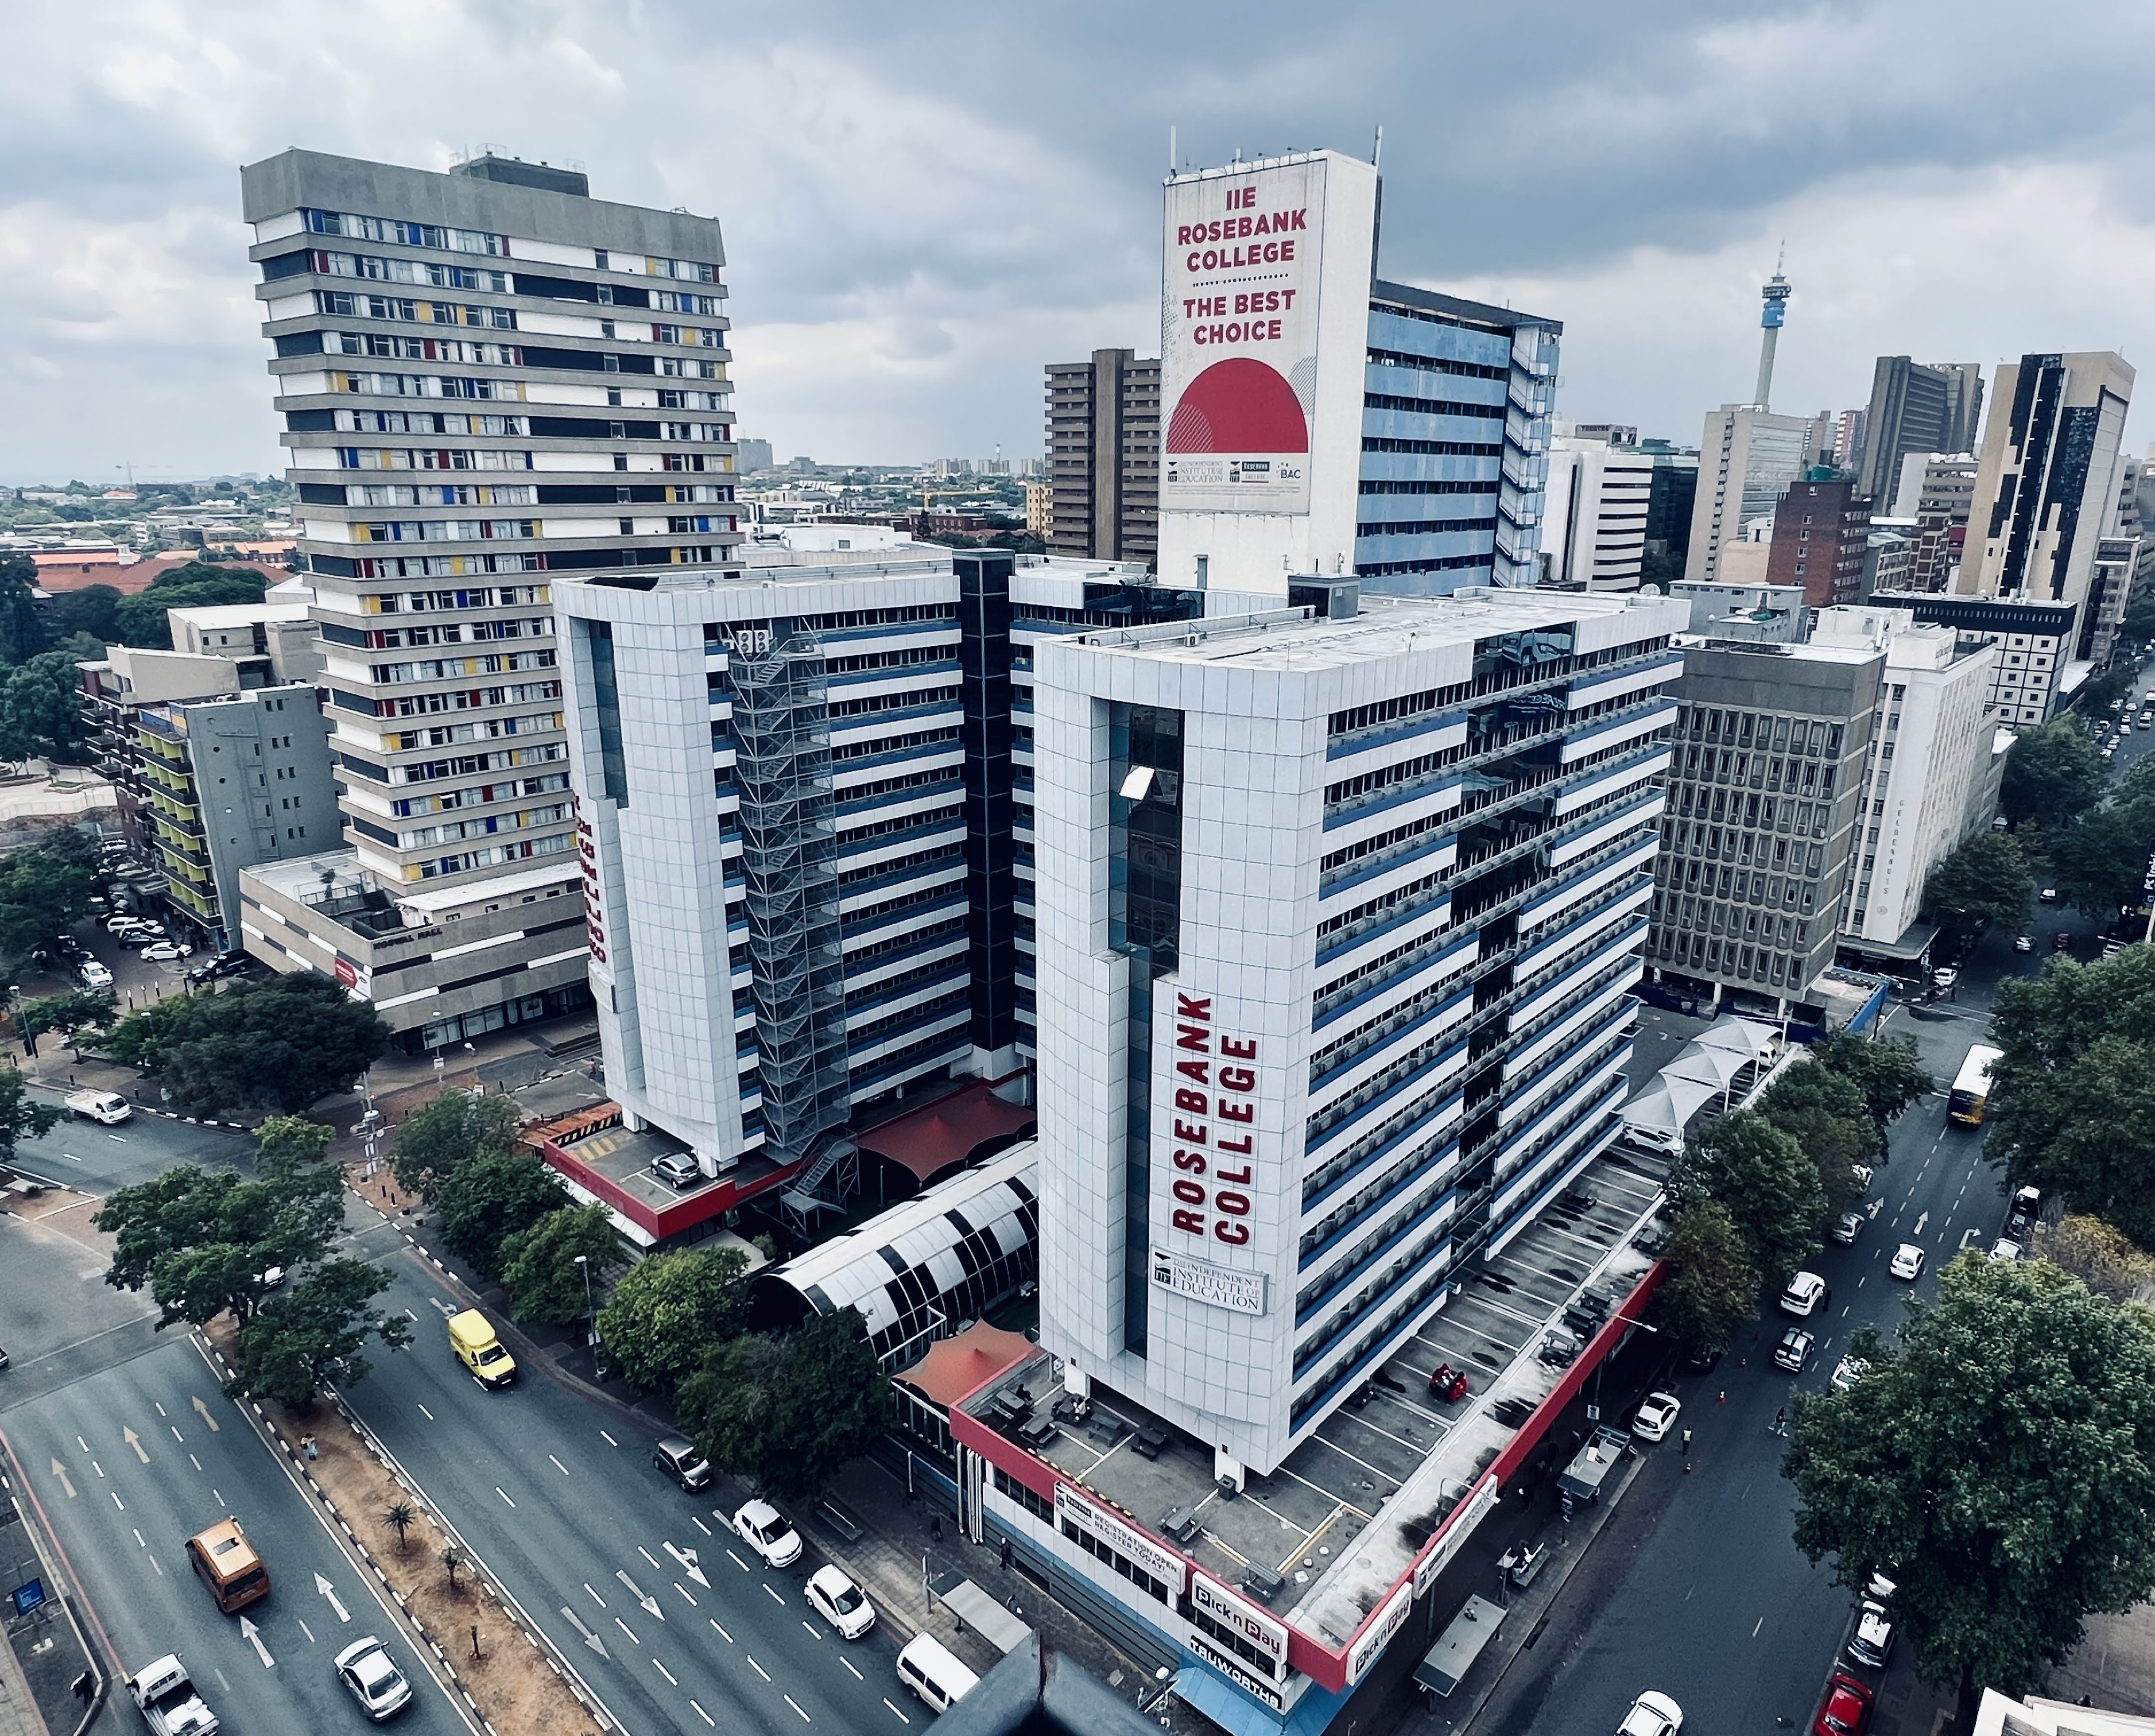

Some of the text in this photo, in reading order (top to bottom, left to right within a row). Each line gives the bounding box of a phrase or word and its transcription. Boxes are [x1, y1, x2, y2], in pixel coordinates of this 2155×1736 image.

[1226, 186, 1256, 211] IIE
[1178, 208, 1307, 245] ROSEBANK
[1187, 241, 1295, 272] COLLEGE
[1183, 289, 1296, 318] THE BEST
[1194, 319, 1281, 344] CHOICE
[1281, 470, 1301, 479] BAC
[1172, 991, 1211, 1235] ROSEBANK
[1214, 1034, 1257, 1246] COLLEGE
[1173, 1266, 1244, 1295] INSTITUTE
[1187, 1263, 1260, 1288] INDEPENDENT
[1173, 1277, 1258, 1310] EDUCATION
[1095, 1521, 1131, 1549] REGISTER
[1095, 1513, 1152, 1556] REGISTRATION
[1154, 1553, 1177, 1573] OPEN
[1196, 1585, 1280, 1654] Pick n Pay
[1381, 1628, 1386, 1641] n
